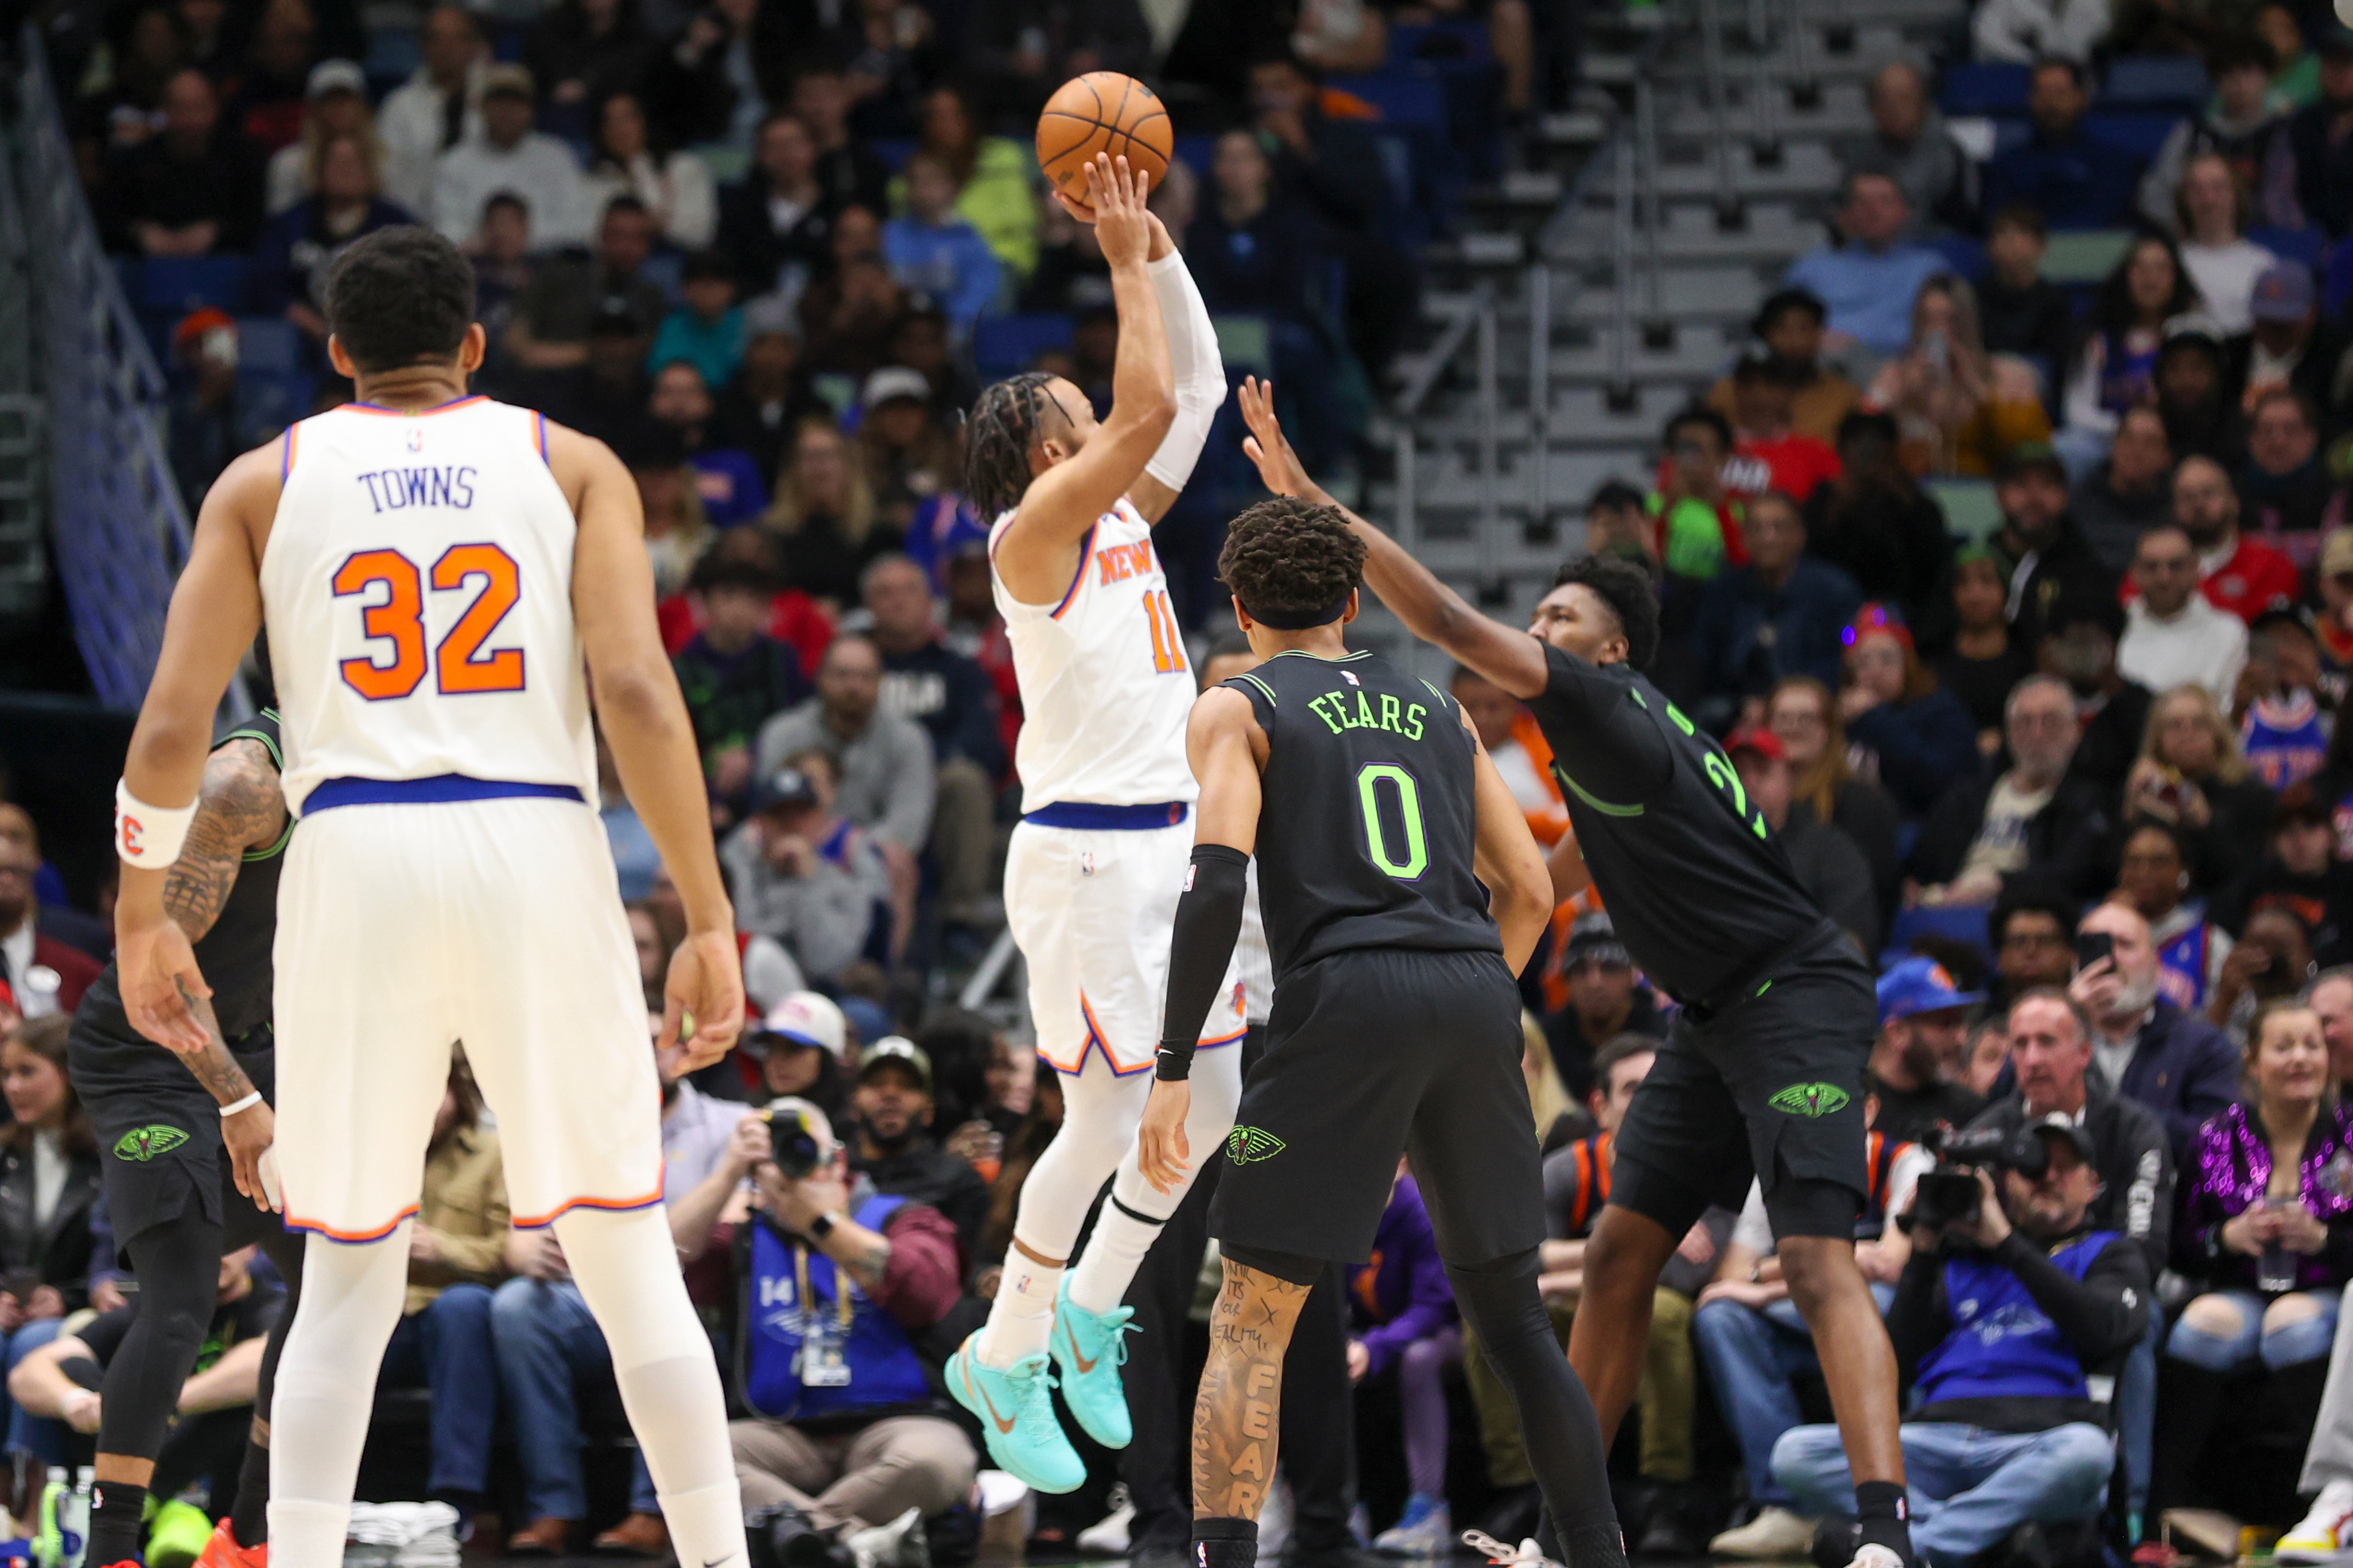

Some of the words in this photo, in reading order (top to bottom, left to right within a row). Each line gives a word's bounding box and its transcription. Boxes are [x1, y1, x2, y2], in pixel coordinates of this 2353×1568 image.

[357, 466, 477, 514] TOWNS
[1096, 538, 1152, 587] NEW
[331, 542, 526, 702] 32
[1143, 589, 1187, 675] 11
[1307, 690, 1427, 742] FEARS
[1356, 761, 1431, 882] 0
[759, 1275, 794, 1308] 14
[1227, 1278, 1245, 1300] ITS
[1228, 1363, 1278, 1520] FEAR
